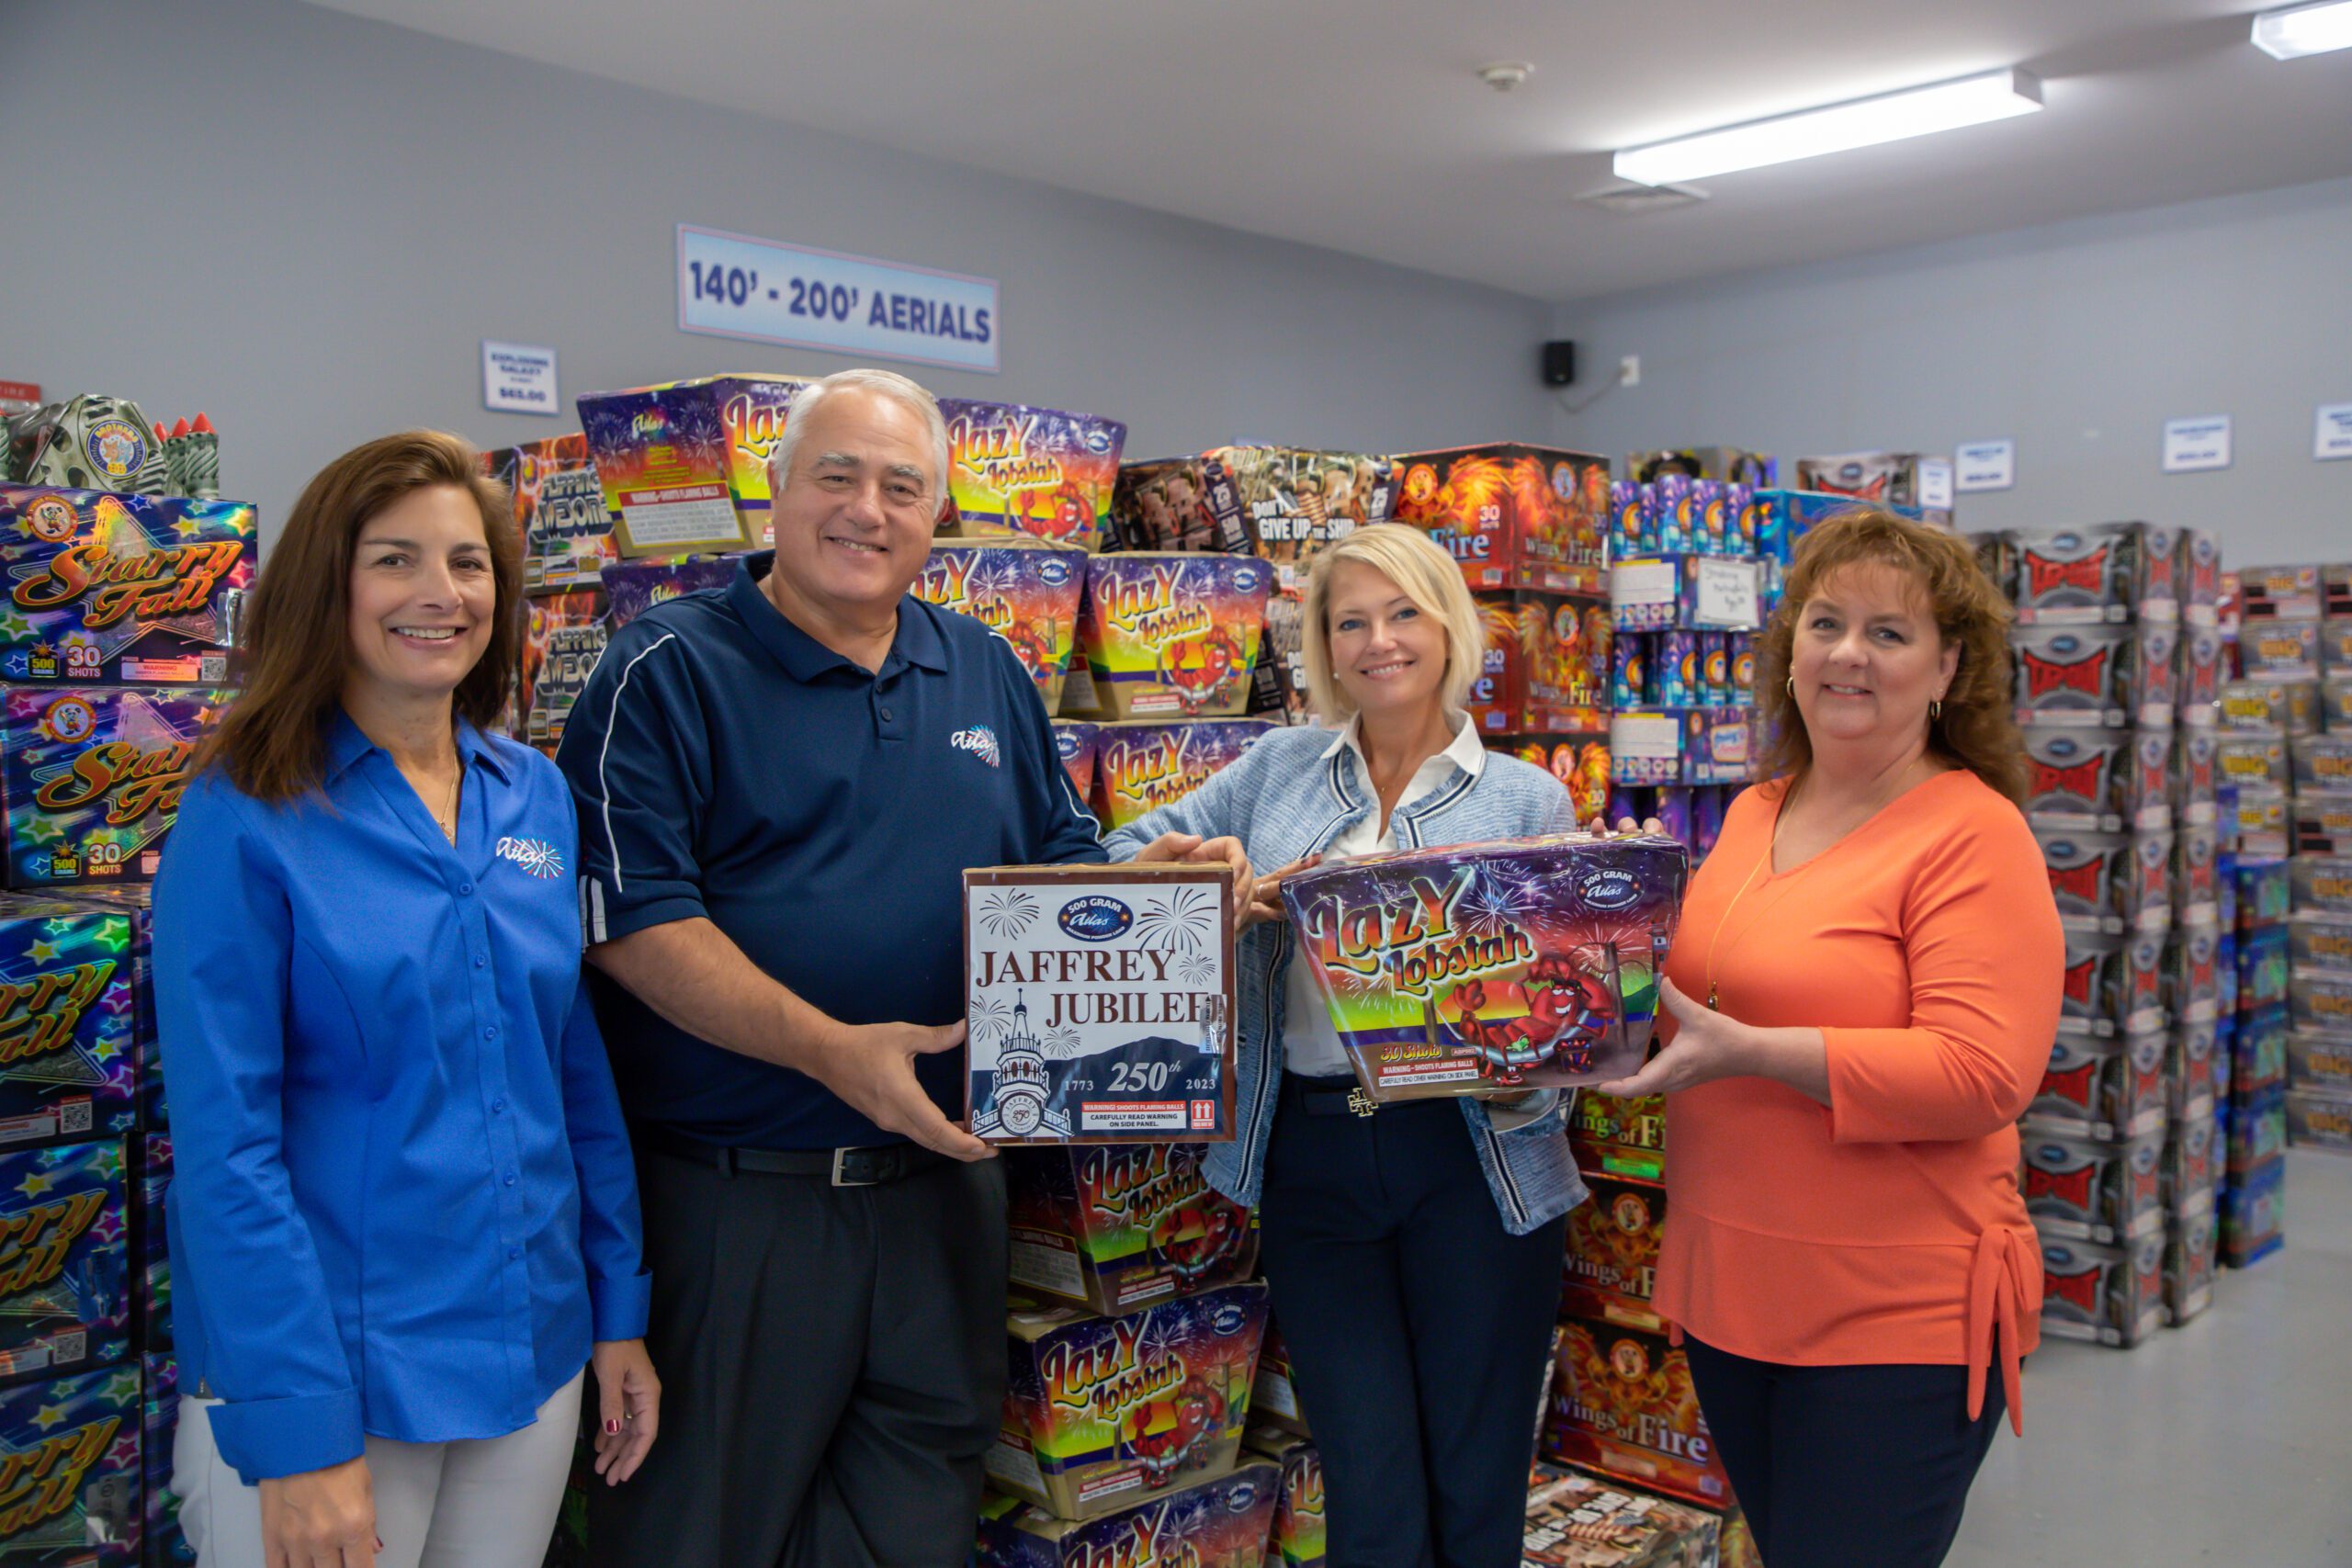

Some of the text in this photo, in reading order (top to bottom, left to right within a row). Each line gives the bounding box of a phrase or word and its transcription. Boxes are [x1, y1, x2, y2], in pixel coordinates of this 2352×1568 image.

[691, 261, 757, 307] 140'
[789, 278, 859, 322] 200'
[868, 291, 990, 343] AERIALS
[1479, 504, 1500, 522] 30
[1259, 517, 1291, 540] GIVE
[1292, 517, 1312, 539] UP
[13, 541, 244, 606] Starry
[83, 570, 214, 627] Fall
[31, 659, 55, 670] 500
[67, 646, 101, 666] 30
[68, 667, 101, 677] SHOTS
[89, 843, 121, 863] 30
[496, 836, 547, 863] Atlas
[53, 858, 77, 869] 500
[89, 864, 122, 874] SHOTS
[1584, 871, 1633, 887] 500 GRAM
[1587, 885, 1623, 898] Atlas
[1068, 898, 1122, 913] 500 GRAM
[1069, 912, 1110, 926] Atlas
[976, 948, 1176, 987] JAFFREY
[1384, 924, 1533, 996] Lobstah
[1380, 1043, 1442, 1062] 30 Shots
[1434, 1061, 1457, 1069] FLAMING
[1457, 1059, 1474, 1067] BALLS
[1065, 1079, 1094, 1091] 1773
[1185, 1078, 1216, 1090] 2023
[1619, 1129, 1636, 1145] of
[1619, 1279, 1638, 1293] of
[1553, 1395, 1708, 1461] Wings of Fire
